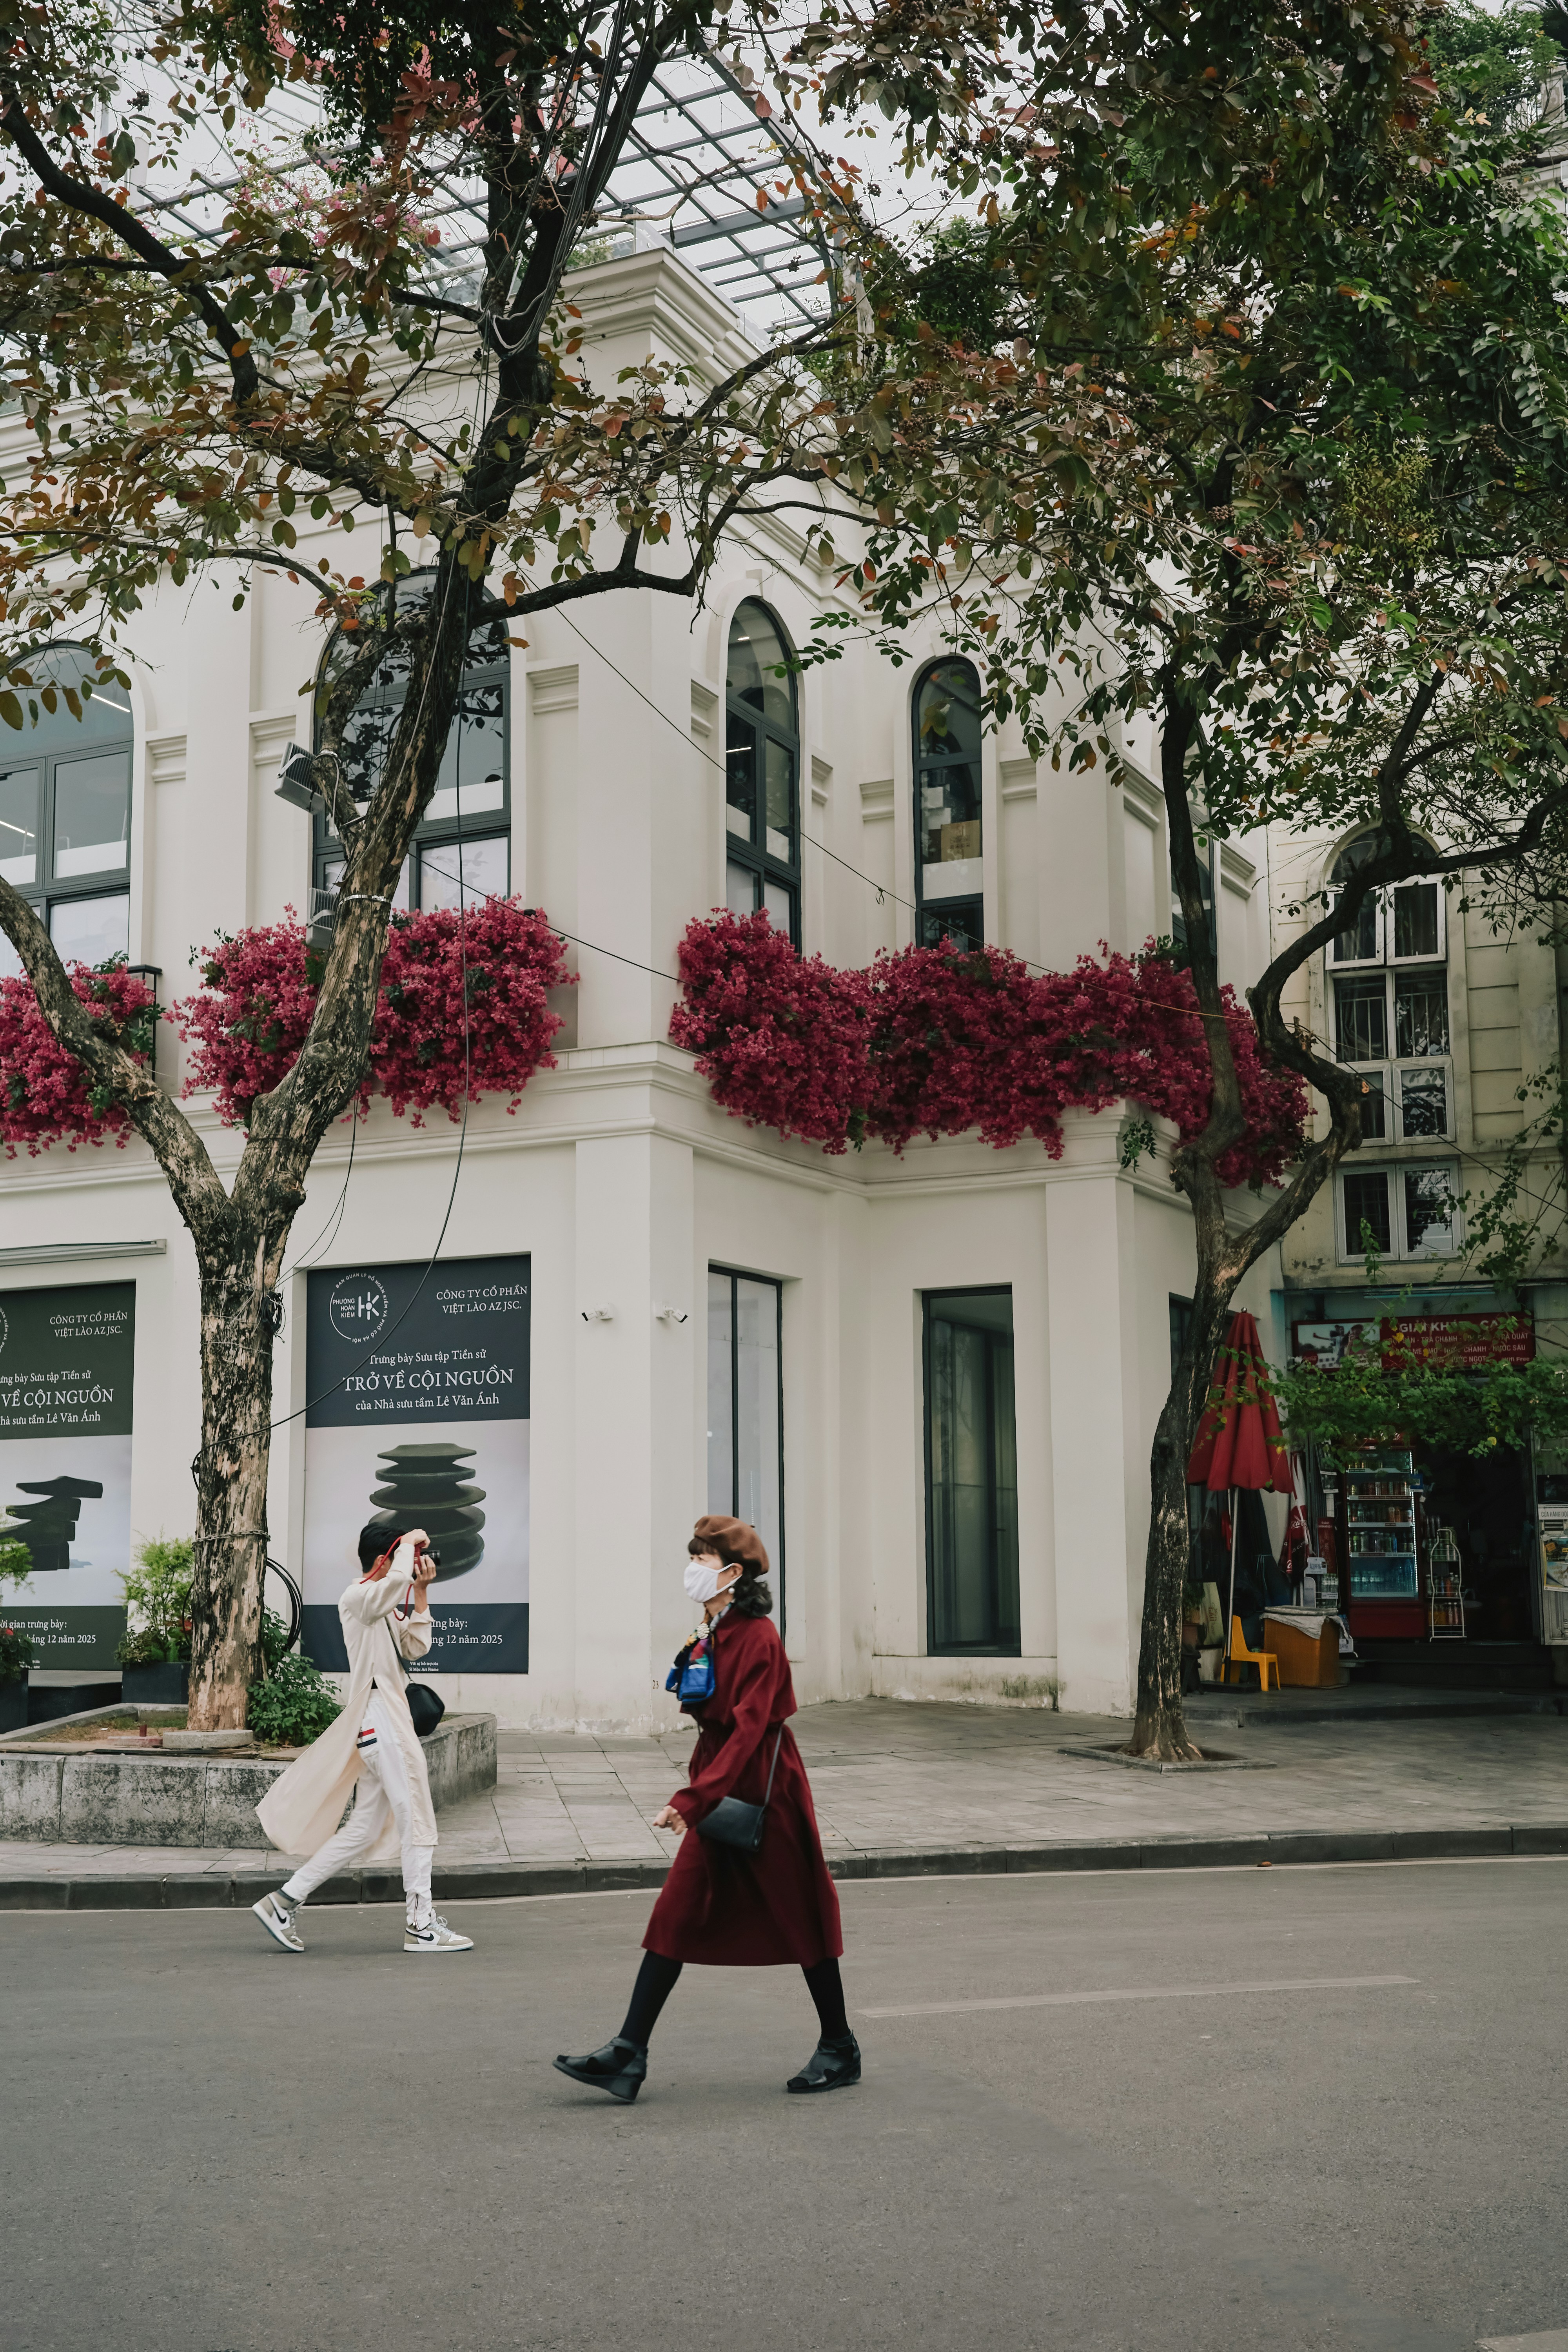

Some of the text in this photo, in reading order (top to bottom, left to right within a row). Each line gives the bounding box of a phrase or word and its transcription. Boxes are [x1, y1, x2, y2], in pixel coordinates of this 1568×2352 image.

[336, 1279, 345, 1288] BAN
[436, 1285, 527, 1300] CÔNG TY CỔ PHẦN
[443, 1301, 521, 1314] VIỆT LÀO AZ JSC.
[50, 1315, 74, 1324] CÔNG
[90, 1311, 102, 1322] CỔ
[104, 1310, 127, 1321] PHẦN
[54, 1327, 73, 1338] VIỆT
[76, 1326, 92, 1336] LÀO
[106, 1326, 122, 1336] JSC.
[370, 1349, 486, 1366] Trưng bày Sưu tập Tiền sử
[15, 1374, 28, 1385] bày
[30, 1373, 44, 1381] Sưu
[47, 1372, 59, 1383] tập
[61, 1370, 79, 1380] Tiền
[82, 1370, 91, 1379] sử
[343, 1365, 513, 1391] TRỞ VỀ CỘI NGUỒN
[1, 1384, 113, 1408] VỀ CỘI NGUỒN
[356, 1392, 499, 1410] của Nhà sưu tầm Lê Văn Ánh
[0, 1416, 10, 1425] hà
[29, 1414, 44, 1424] tầm
[47, 1413, 57, 1423] Lê
[60, 1413, 78, 1422] Văn
[81, 1409, 100, 1421] Ánh
[9, 1620, 25, 1630] gian
[28, 1621, 49, 1631] trưng
[51, 1619, 67, 1630] bày:
[449, 1618, 467, 1630] bày:
[48, 1635, 56, 1643] 12
[77, 1635, 96, 1643] 2025
[447, 1635, 456, 1643] 12
[459, 1635, 479, 1643] năm
[481, 1635, 502, 1644] 2025
[653, 1680, 659, 1689] 23
